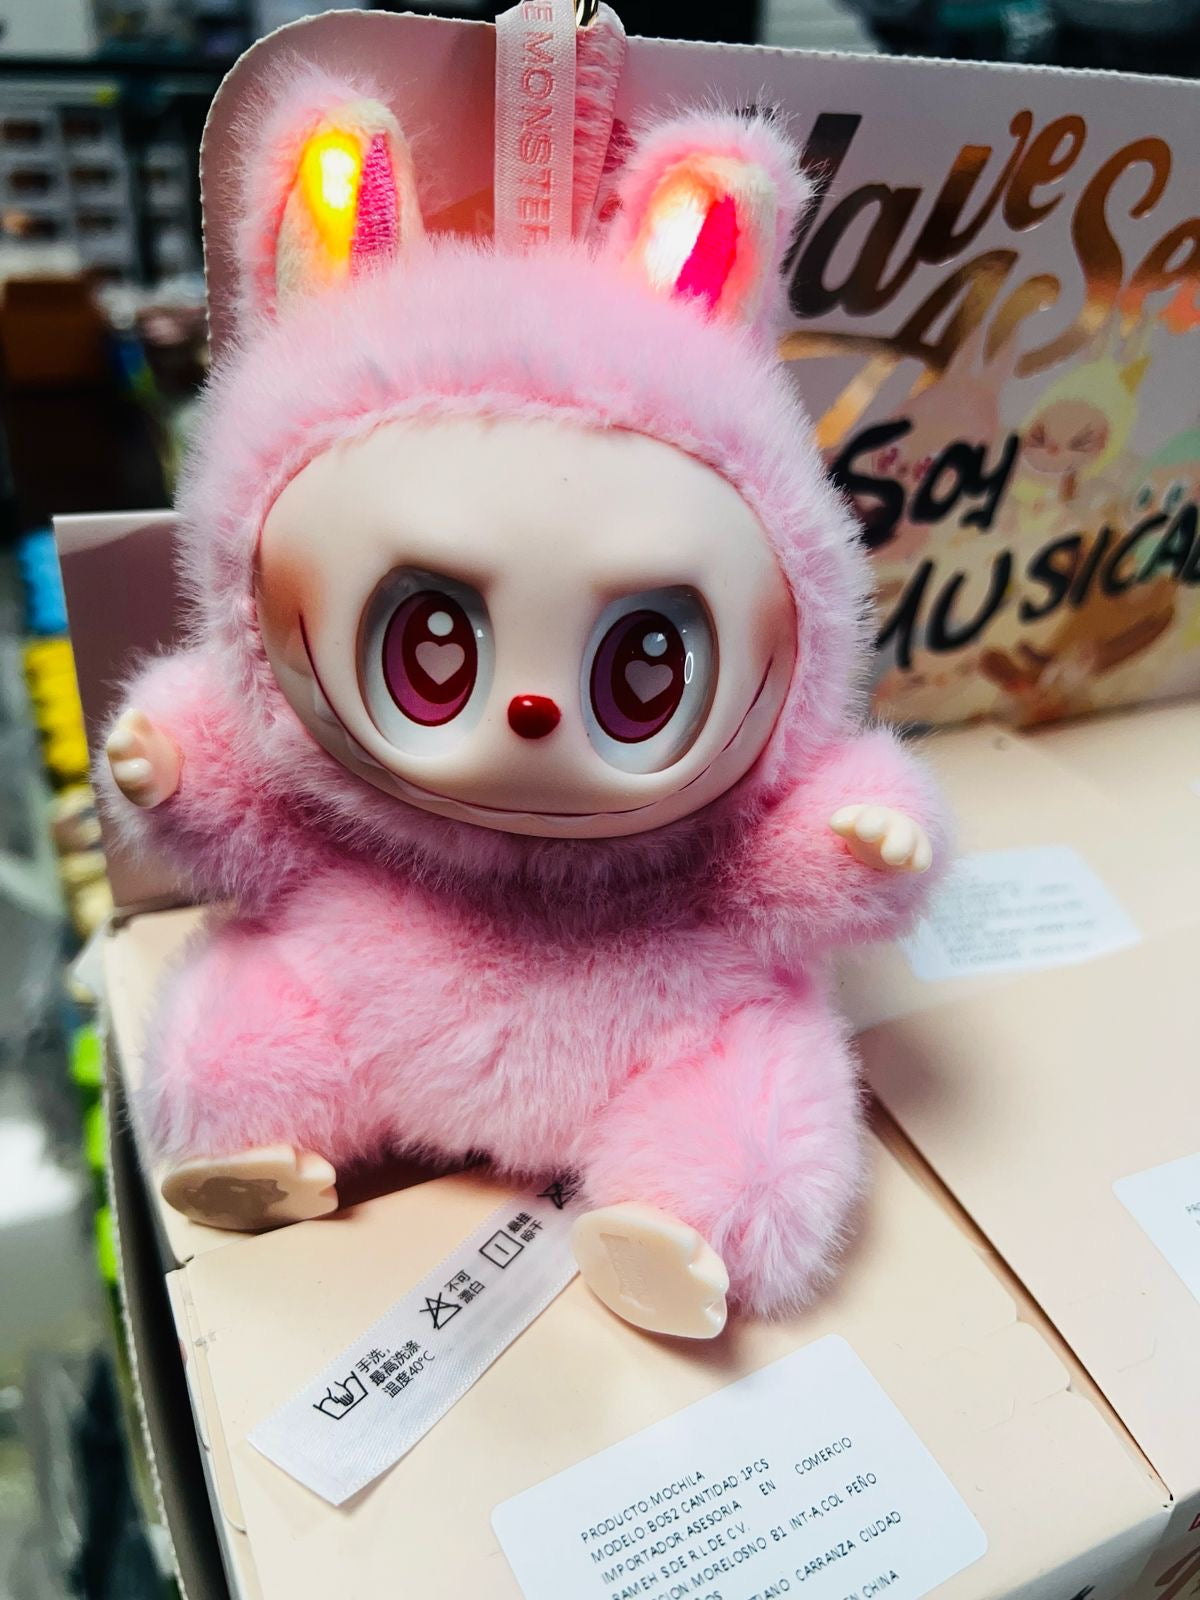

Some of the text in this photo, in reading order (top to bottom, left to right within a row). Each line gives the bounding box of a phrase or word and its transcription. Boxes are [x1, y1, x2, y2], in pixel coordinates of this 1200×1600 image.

[444, 1269, 471, 1293] 不可
[457, 1280, 486, 1305] 漂白
[369, 1339, 422, 1388] 最高洗涤
[759, 1479, 777, 1496] EN
[794, 1437, 853, 1475] COMERCIO
[770, 1525, 788, 1542] 81
[845, 1472, 878, 1497] PEÑO
[795, 1540, 857, 1582] CARRANZA
[859, 1511, 902, 1543] CIUDAD
[862, 1570, 900, 1599] CHINA
